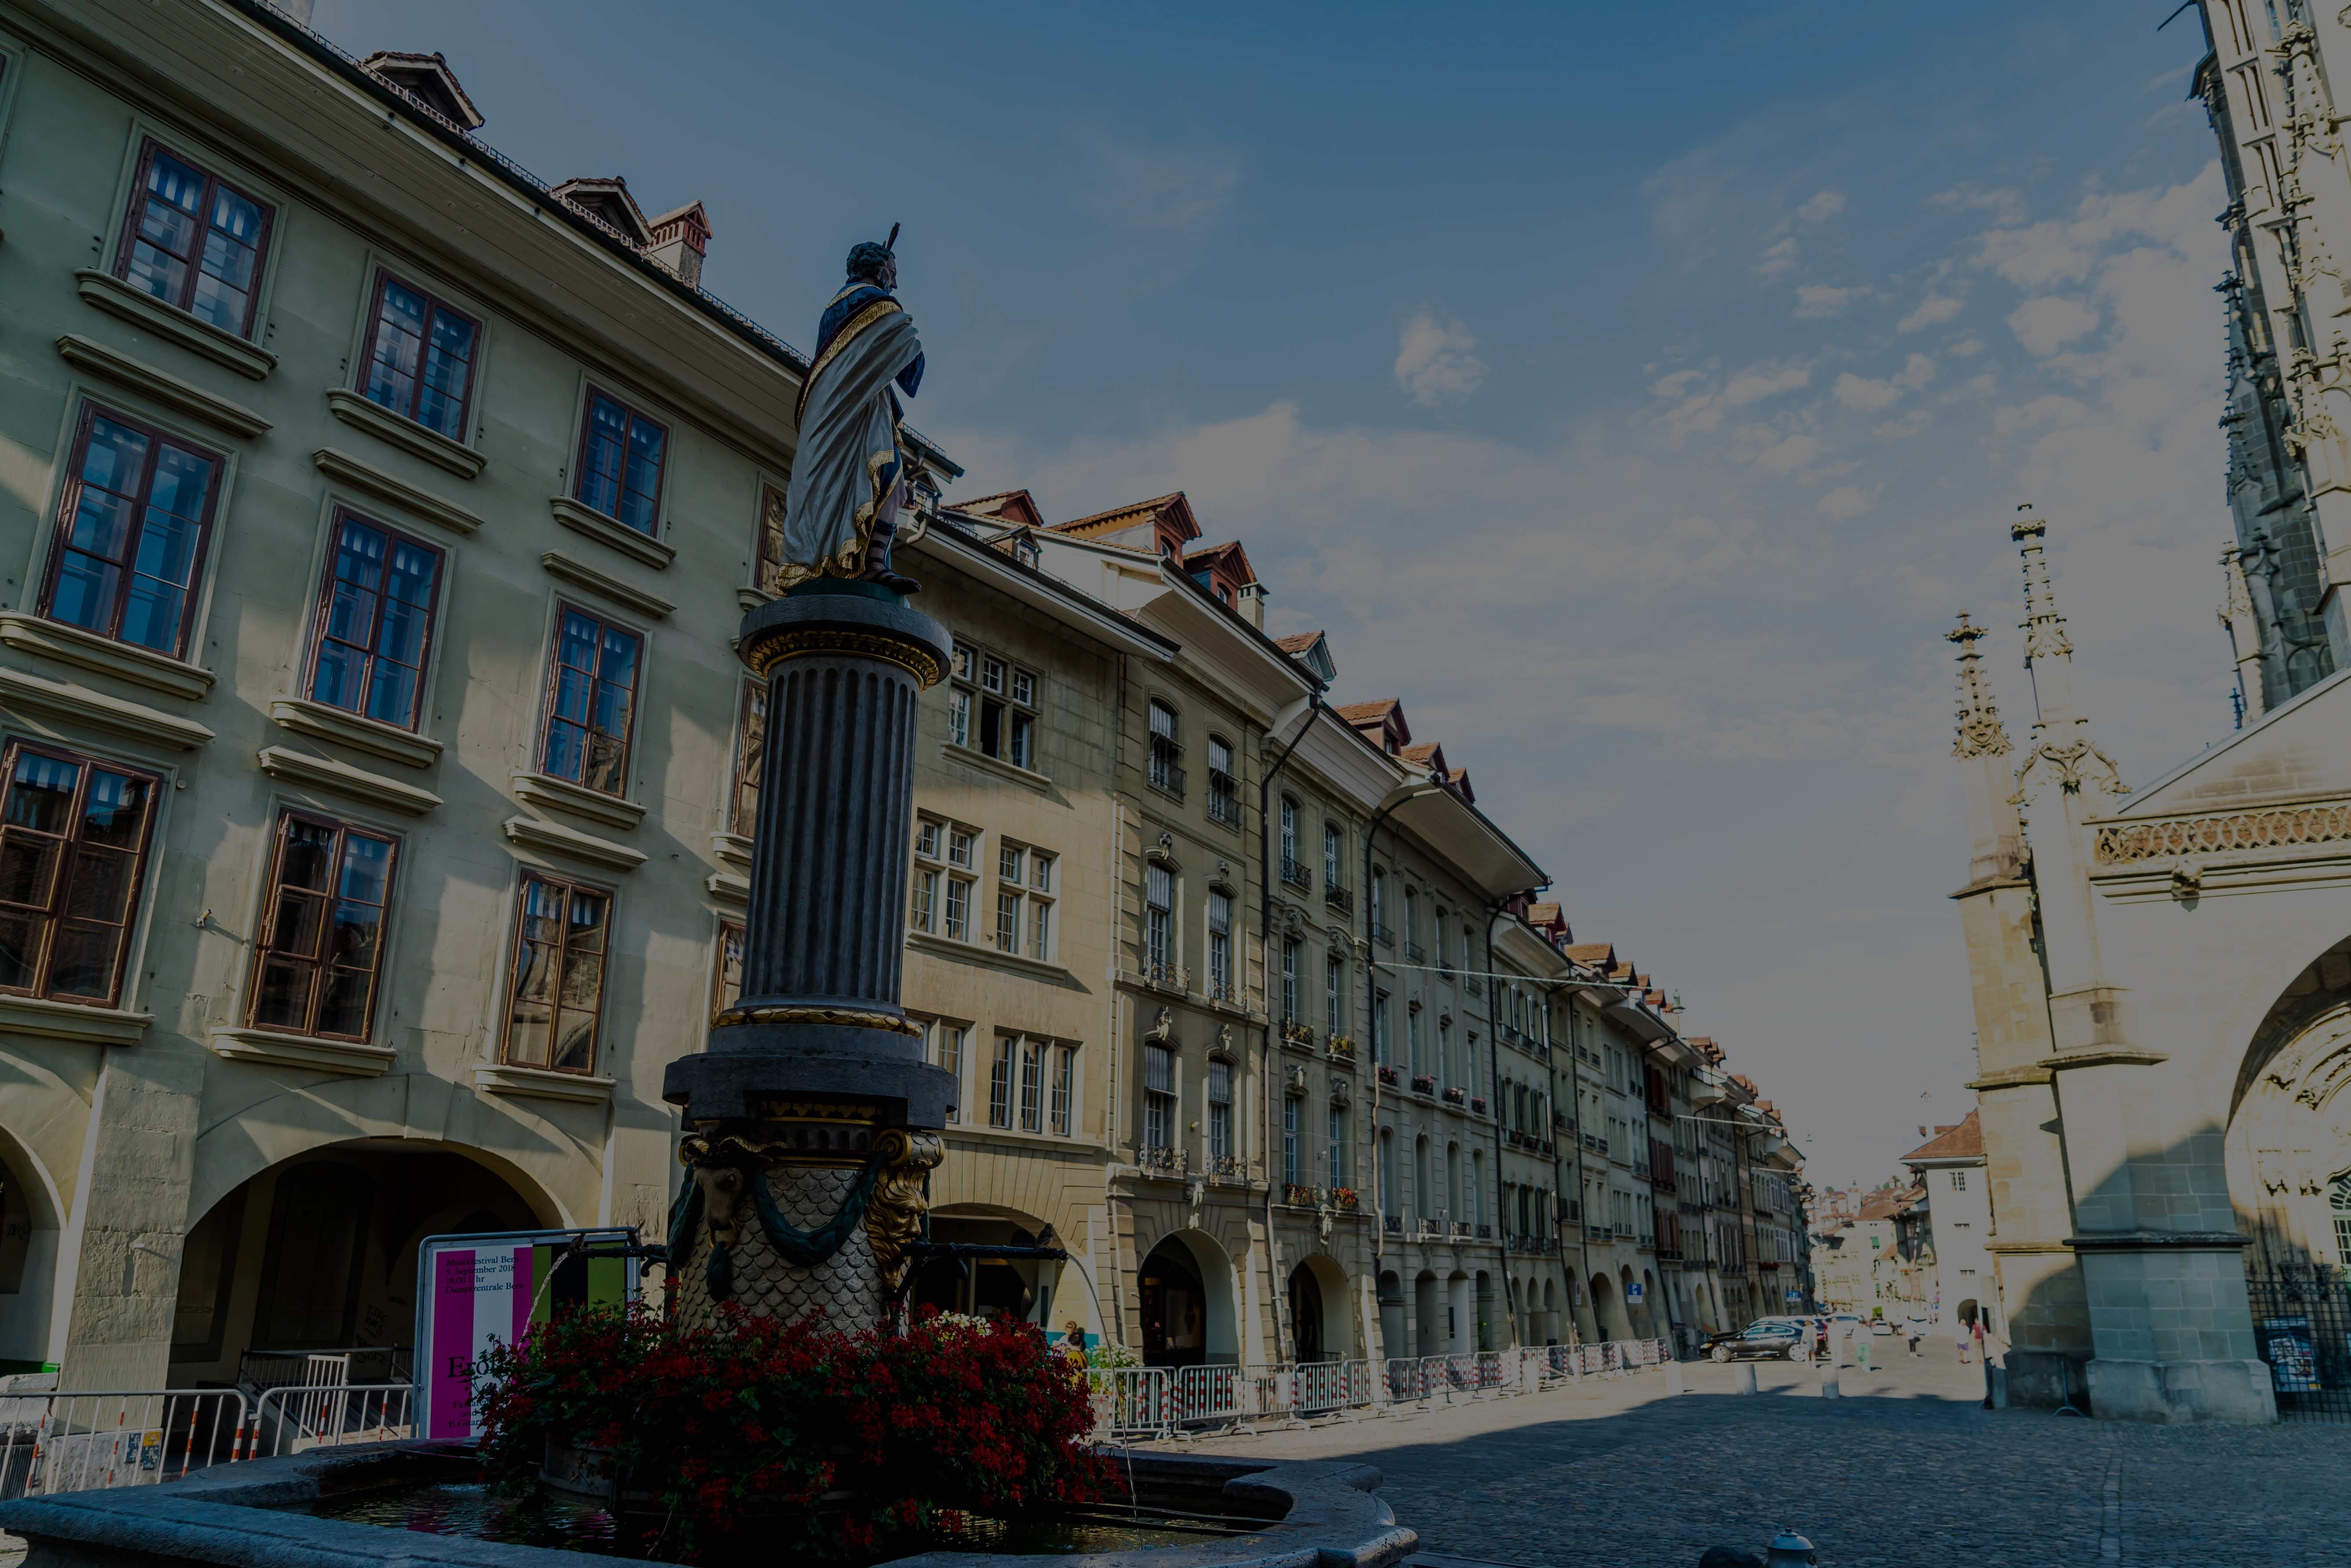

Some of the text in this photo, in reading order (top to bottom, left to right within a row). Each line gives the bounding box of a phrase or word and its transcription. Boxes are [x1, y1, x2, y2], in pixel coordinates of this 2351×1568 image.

[447, 1256, 498, 1266] Musikfestival
[455, 1266, 496, 1275] September
[445, 1283, 503, 1294] Dampfzentrale
